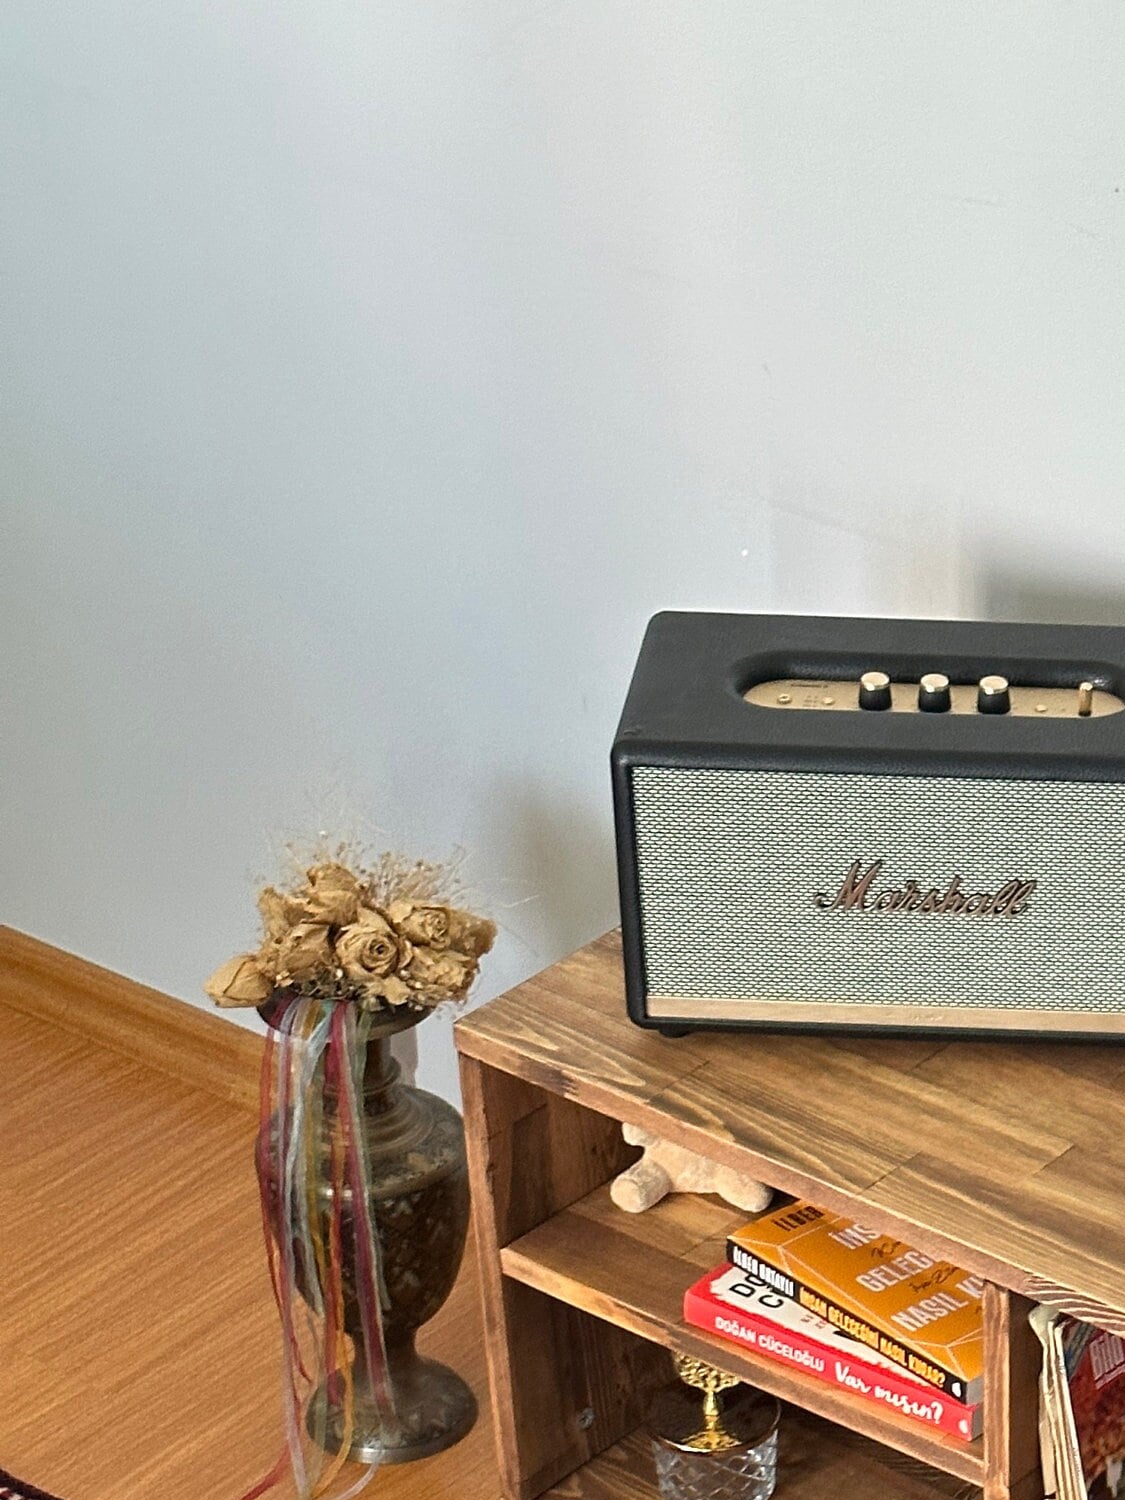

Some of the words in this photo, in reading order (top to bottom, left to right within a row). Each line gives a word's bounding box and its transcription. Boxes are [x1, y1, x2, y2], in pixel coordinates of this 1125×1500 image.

[815, 859, 1036, 918] Marshall
[890, 1292, 969, 1332] NASIL
[714, 1316, 757, 1344] DOĞAN
[758, 1334, 825, 1373] CÜCELOĞLU
[835, 1361, 871, 1394] Var
